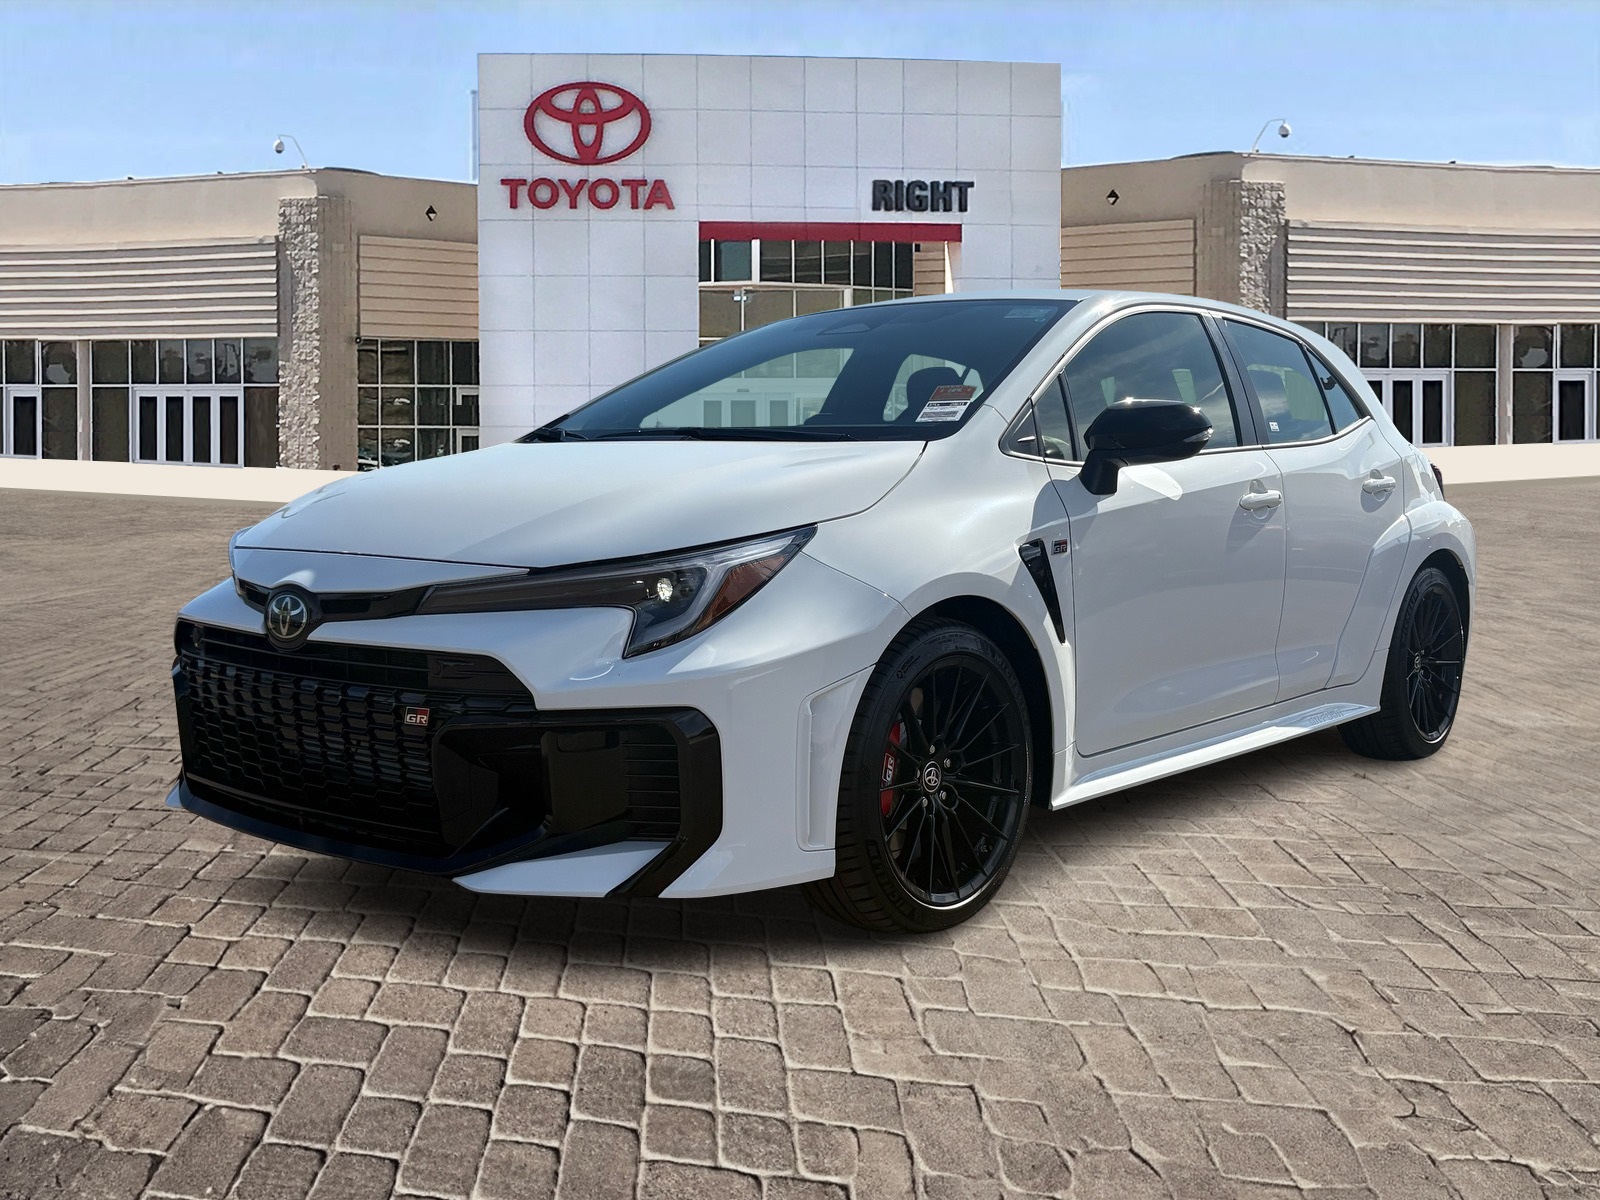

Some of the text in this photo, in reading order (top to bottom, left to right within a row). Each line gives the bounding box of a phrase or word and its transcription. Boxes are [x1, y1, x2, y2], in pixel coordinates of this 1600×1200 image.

[500, 178, 676, 210] TOYOTA
[872, 179, 975, 212] RIGHT
[406, 713, 427, 724] GR
